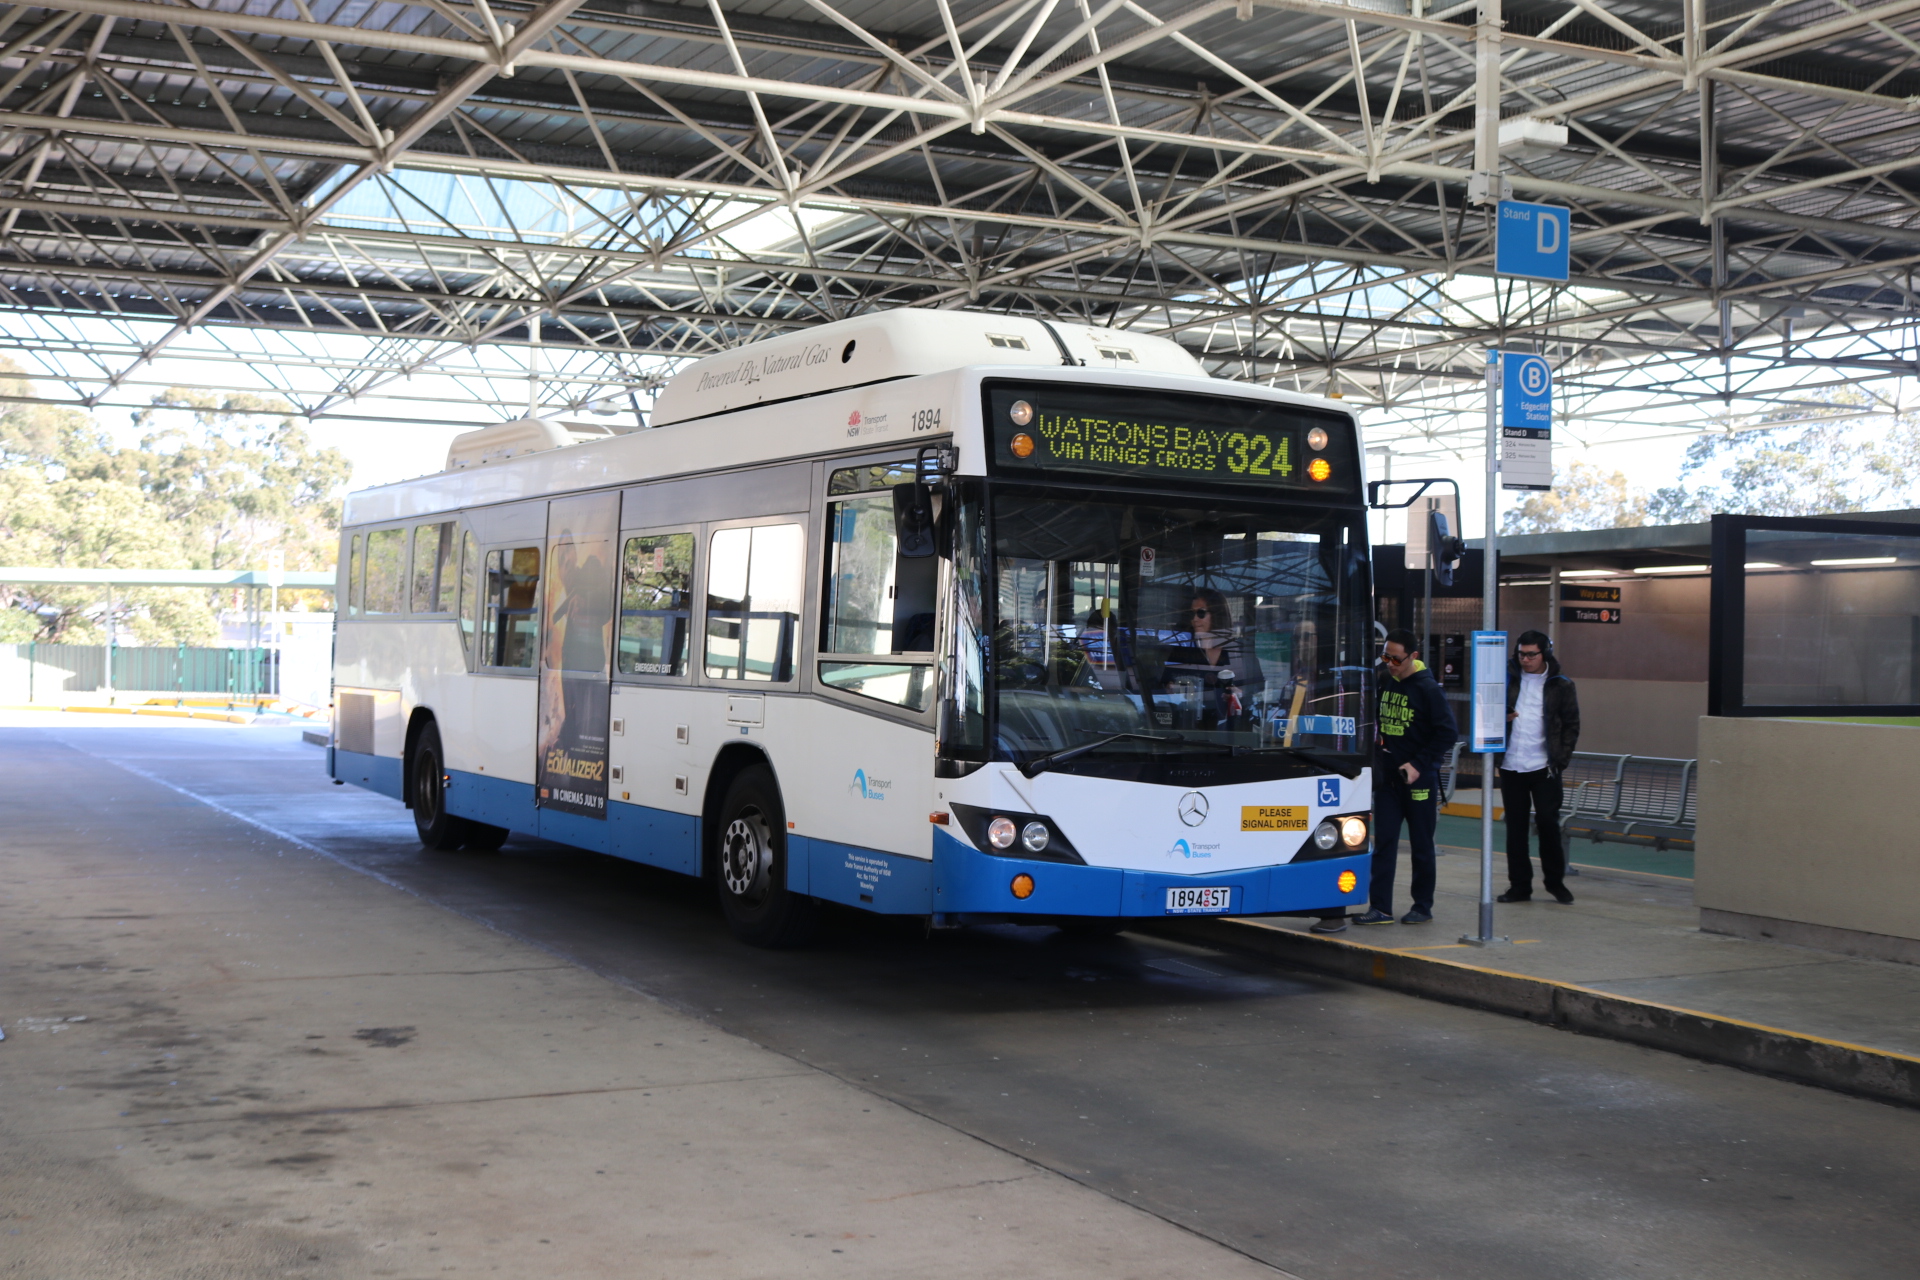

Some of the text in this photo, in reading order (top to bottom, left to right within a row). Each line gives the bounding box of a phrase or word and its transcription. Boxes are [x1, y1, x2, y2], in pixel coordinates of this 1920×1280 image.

[1503, 207, 1531, 221] Stand
[1536, 212, 1561, 255] D
[696, 368, 740, 392] Powered
[757, 350, 804, 377] Natural
[805, 343, 832, 367] Gas
[1520, 401, 1550, 412] Edgecliff
[864, 413, 888, 426] Transport
[911, 407, 941, 433] 1894
[1525, 412, 1550, 422] Station
[846, 426, 860, 438] NSW
[862, 424, 889, 436] State Transit
[1038, 413, 1230, 454] WATSONS BAY
[1504, 428, 1521, 437] Stand
[1504, 440, 1517, 448] 324
[1049, 440, 1217, 471] VIA KINGS CROSS
[1227, 431, 1293, 478] 324
[1580, 589, 1609, 600] Way out
[1576, 610, 1599, 620] Trains
[634, 662, 672, 674] EMERGENCY EXIT
[1304, 717, 1315, 732] W
[556, 749, 565, 757] THE
[867, 776, 892, 790] Transport
[553, 788, 560, 801] IN
[560, 789, 584, 806] CINEMAS
[584, 793, 598, 808] JULY
[597, 796, 604, 809] 19
[868, 789, 885, 801] Buses
[1259, 807, 1293, 818] PLEASE
[1241, 818, 1308, 829] SIGNAL DRIVER
[1191, 842, 1221, 852] Transport
[1192, 851, 1212, 859] Buses
[864, 865, 879, 875] Authority
[1171, 889, 1229, 908] 1894 ST
